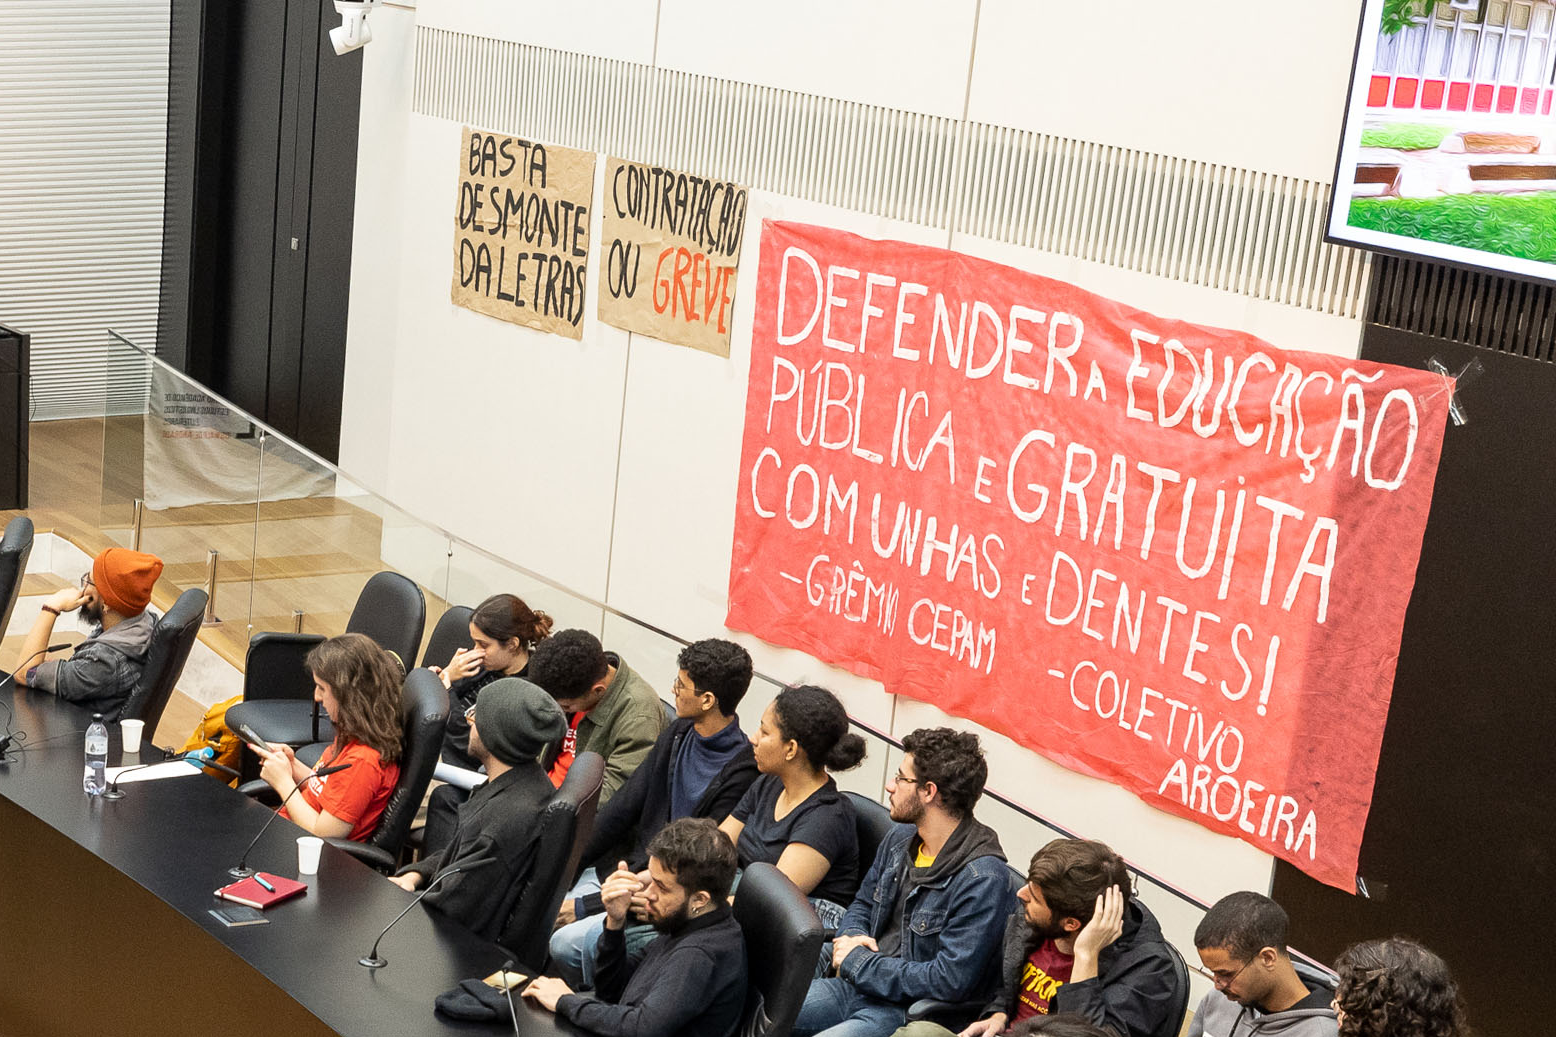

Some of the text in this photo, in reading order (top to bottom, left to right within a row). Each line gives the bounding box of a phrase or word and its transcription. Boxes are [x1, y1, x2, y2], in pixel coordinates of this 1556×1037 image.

[469, 132, 547, 189] BASTA
[458, 181, 587, 257] DESMONTE
[613, 164, 746, 257] CONTRATAÇÃO
[608, 238, 738, 334] OU GREVE
[777, 246, 1419, 490] DEFENDER A EDUCAÇÃO
[766, 355, 955, 484] PÚBLICA
[974, 455, 997, 504] E
[751, 446, 1281, 717] COM UNHAS E DENTES!
[907, 597, 996, 675] CEPAM
[1158, 758, 1317, 861] AROEIRA
